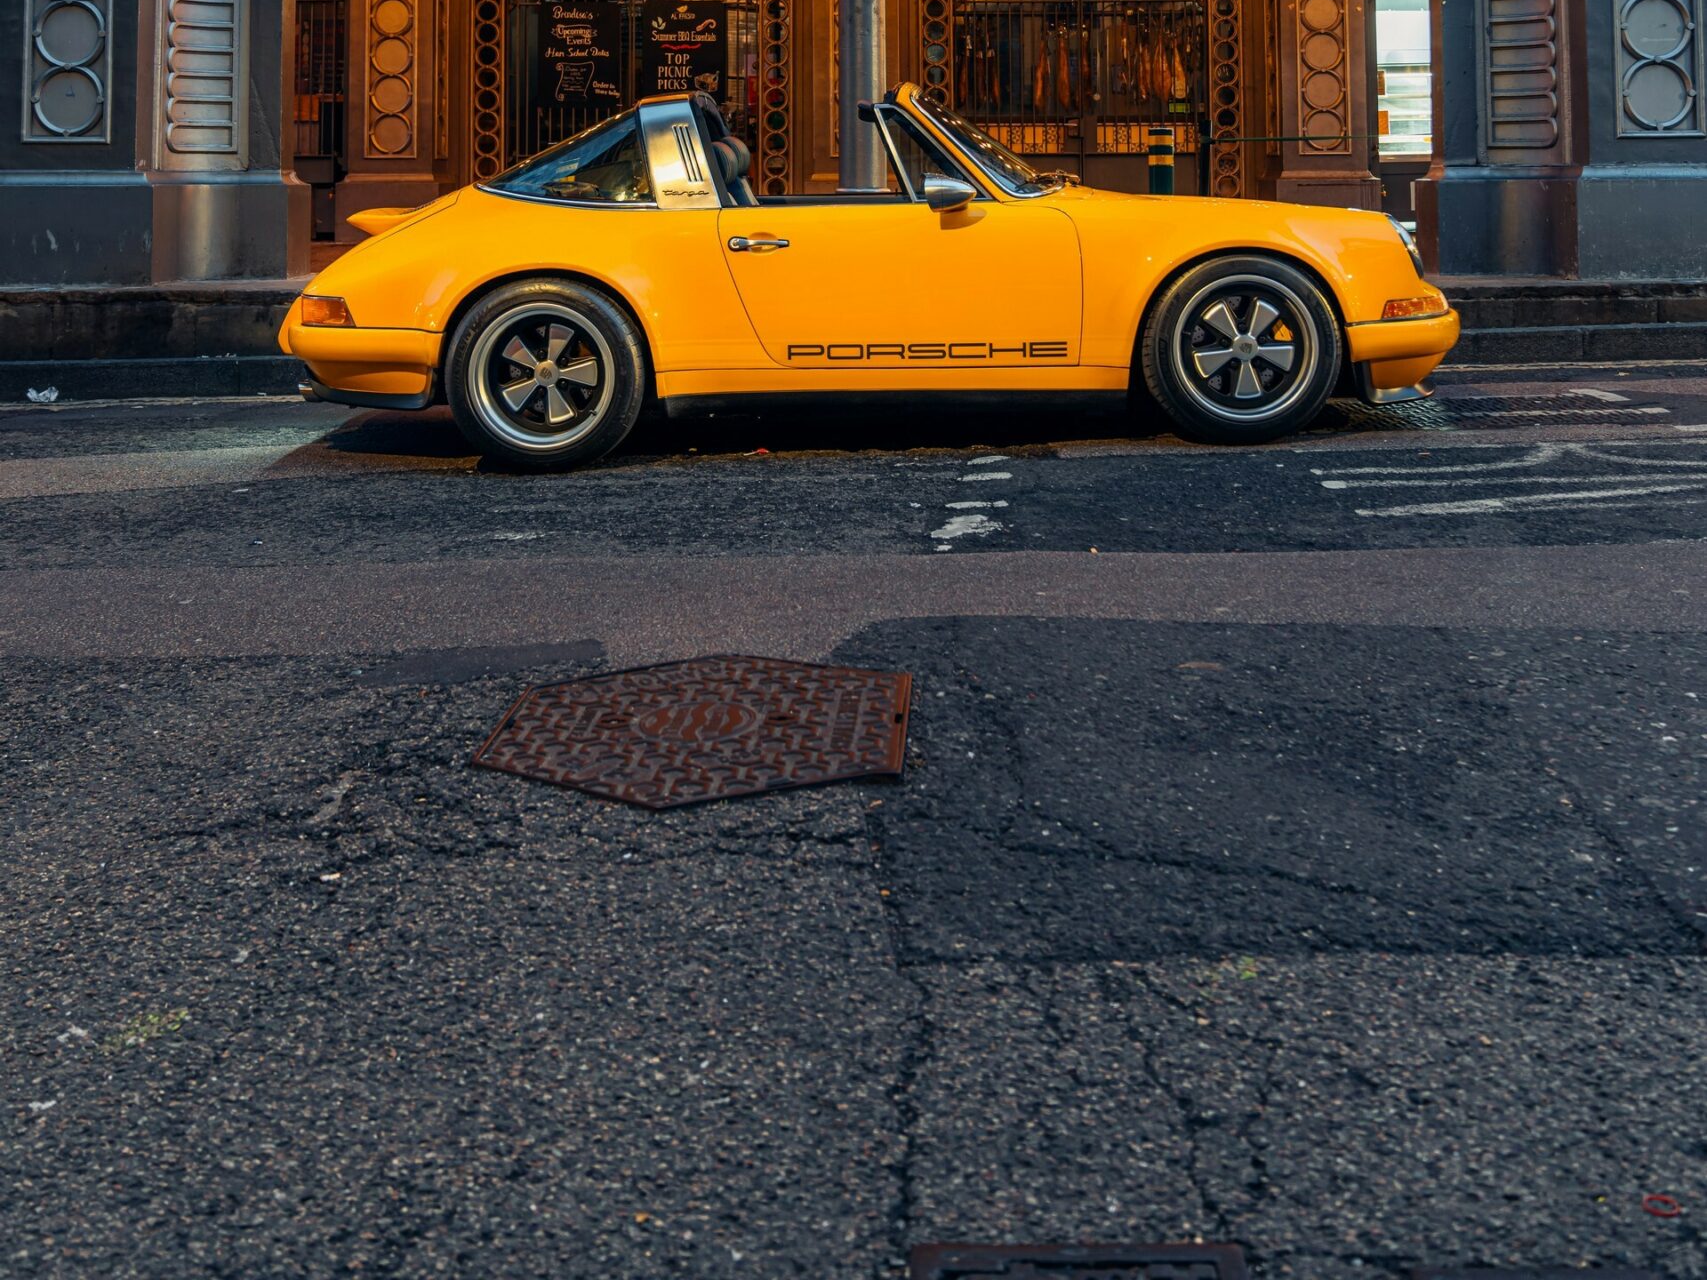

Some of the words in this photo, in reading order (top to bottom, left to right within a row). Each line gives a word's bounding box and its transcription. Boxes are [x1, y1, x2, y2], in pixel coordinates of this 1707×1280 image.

[566, 36, 592, 45] Events
[665, 53, 690, 64] TOP
[658, 66, 692, 77] PICNIC
[657, 79, 688, 90] PICKS
[787, 341, 1068, 361] PORSCHE
